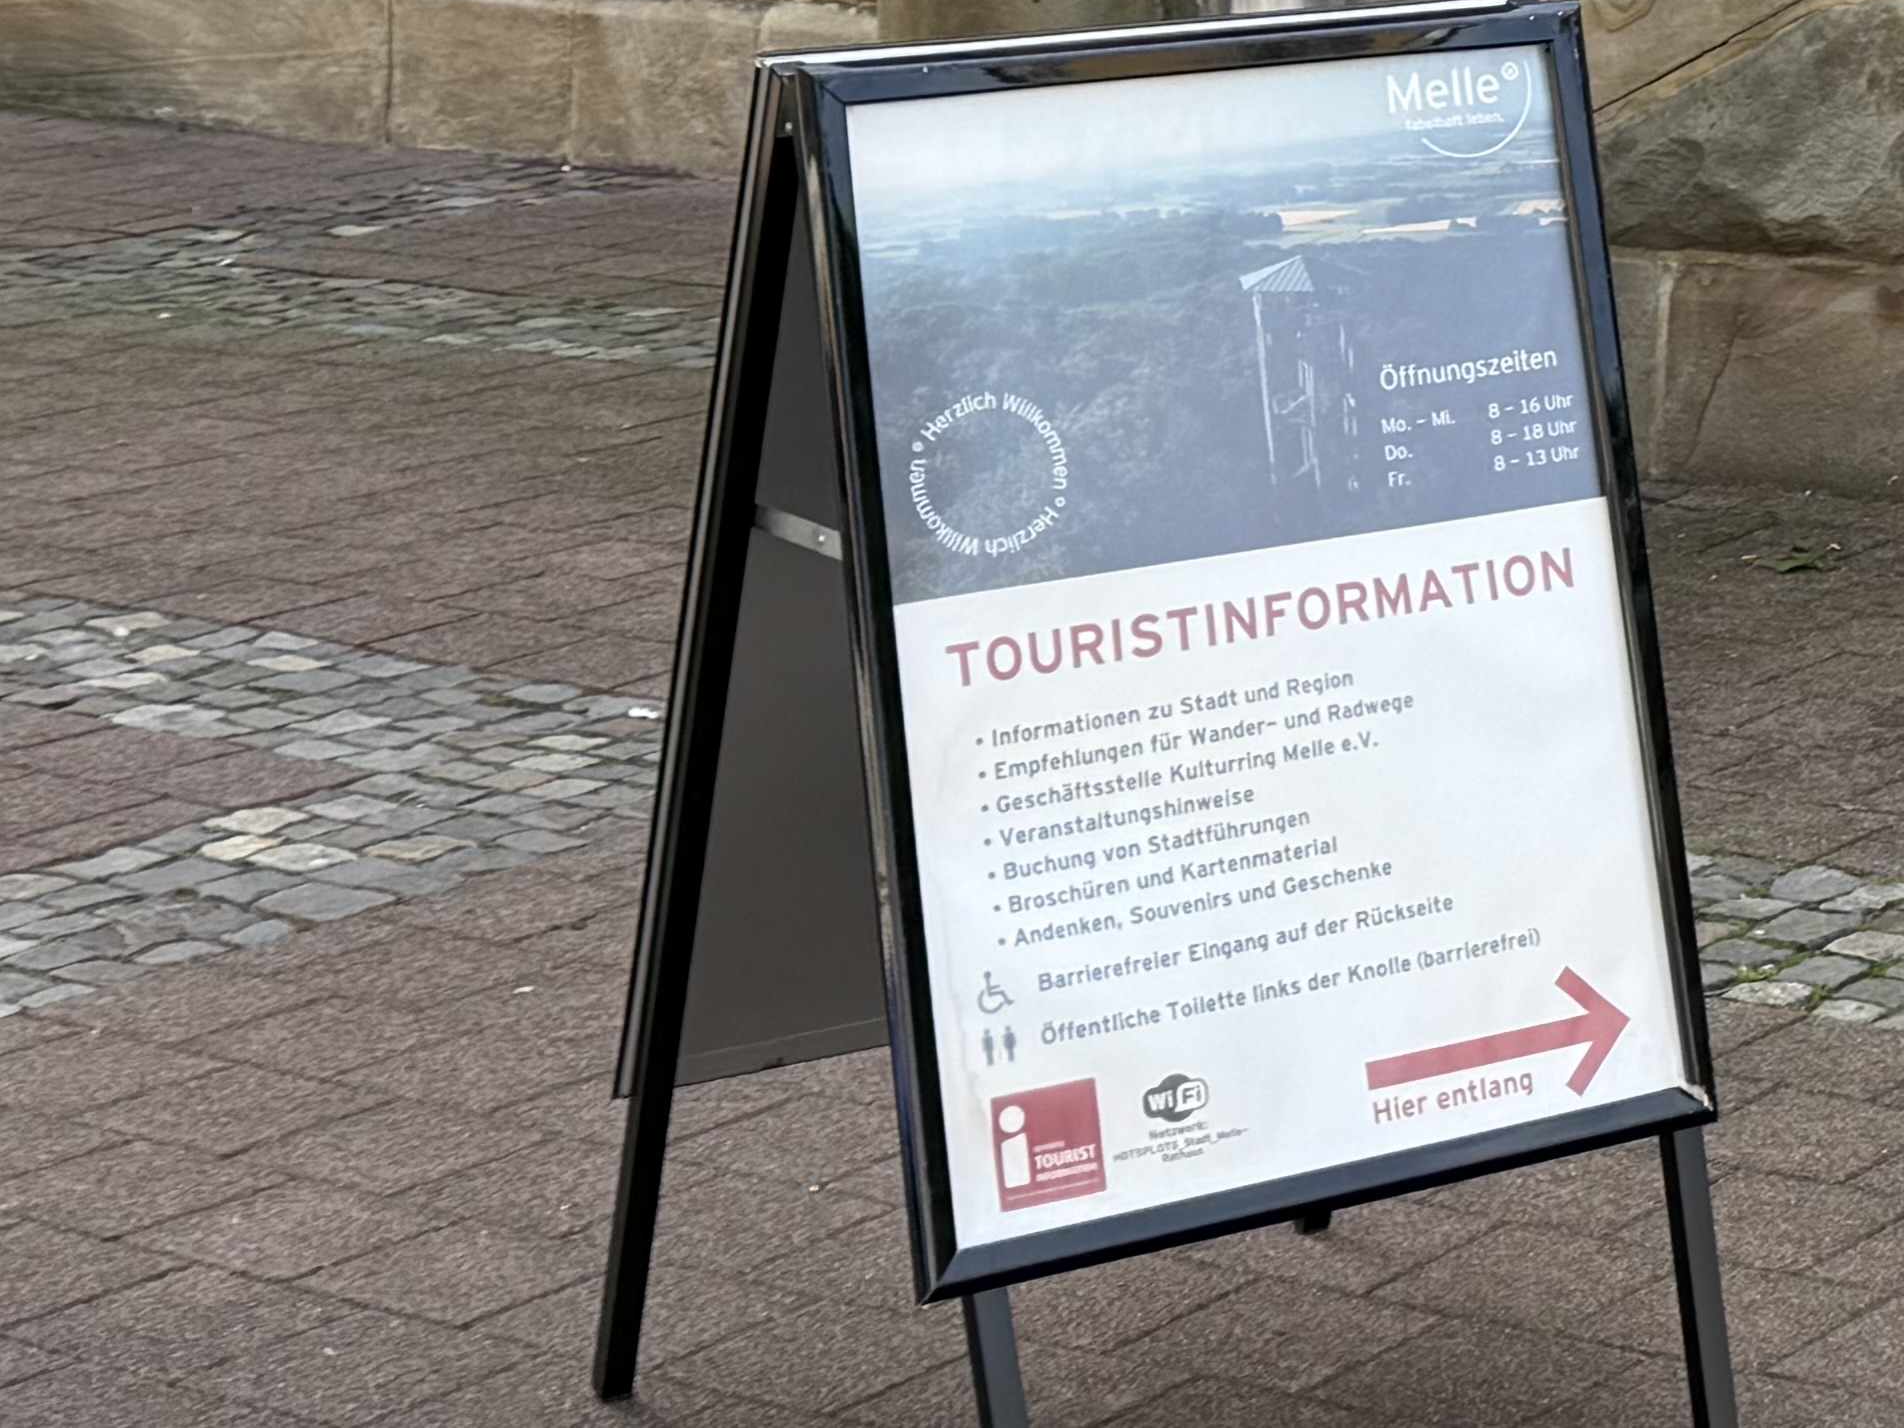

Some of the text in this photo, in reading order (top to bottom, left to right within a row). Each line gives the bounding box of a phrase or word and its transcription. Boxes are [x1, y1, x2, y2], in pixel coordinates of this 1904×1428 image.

[1379, 349, 1558, 391] Öffnungszeiten
[920, 391, 1068, 490] Herzlich Willkommen
[1381, 417, 1412, 434] Mo.
[1431, 409, 1456, 427] Mi.
[1488, 402, 1500, 419] 8
[1520, 397, 1541, 415] 16
[1544, 394, 1574, 411] Uhr
[1490, 429, 1503, 445] 8
[1523, 423, 1544, 441] 18
[1547, 419, 1577, 437] Uhr
[1384, 444, 1413, 461] Do.
[1388, 471, 1412, 488] Fr.
[1494, 455, 1506, 472] 8
[1526, 450, 1547, 467] 13
[1551, 445, 1580, 463] Uhr
[909, 458, 1059, 557] Herzlich Willkommen
[945, 547, 1575, 687] TOURISTINFORMATION
[991, 672, 1354, 747] Informationen zu Stadt und Region
[994, 694, 1414, 780] Empfehlungen für Wander- und Radwege
[996, 730, 1379, 814] Geschäftsstelle Kulturring Melle e.V.
[999, 789, 1255, 847] Veranstaltungshinweise
[1003, 811, 1311, 881] Buchung von Stadtführungen
[1008, 836, 1338, 914] Broschüren und Kartenmaterial
[1013, 861, 1393, 947] Andenken, Souvenirs und Geschenke
[1038, 896, 1454, 993] Barrierefreier Eingang auf der Rückseite
[1041, 927, 1541, 1045] Öffentliche Toilette links der Knolle (barrierefrei)
[1372, 1072, 1534, 1124] Hier entlang
[1034, 1143, 1097, 1170] TOURIST
